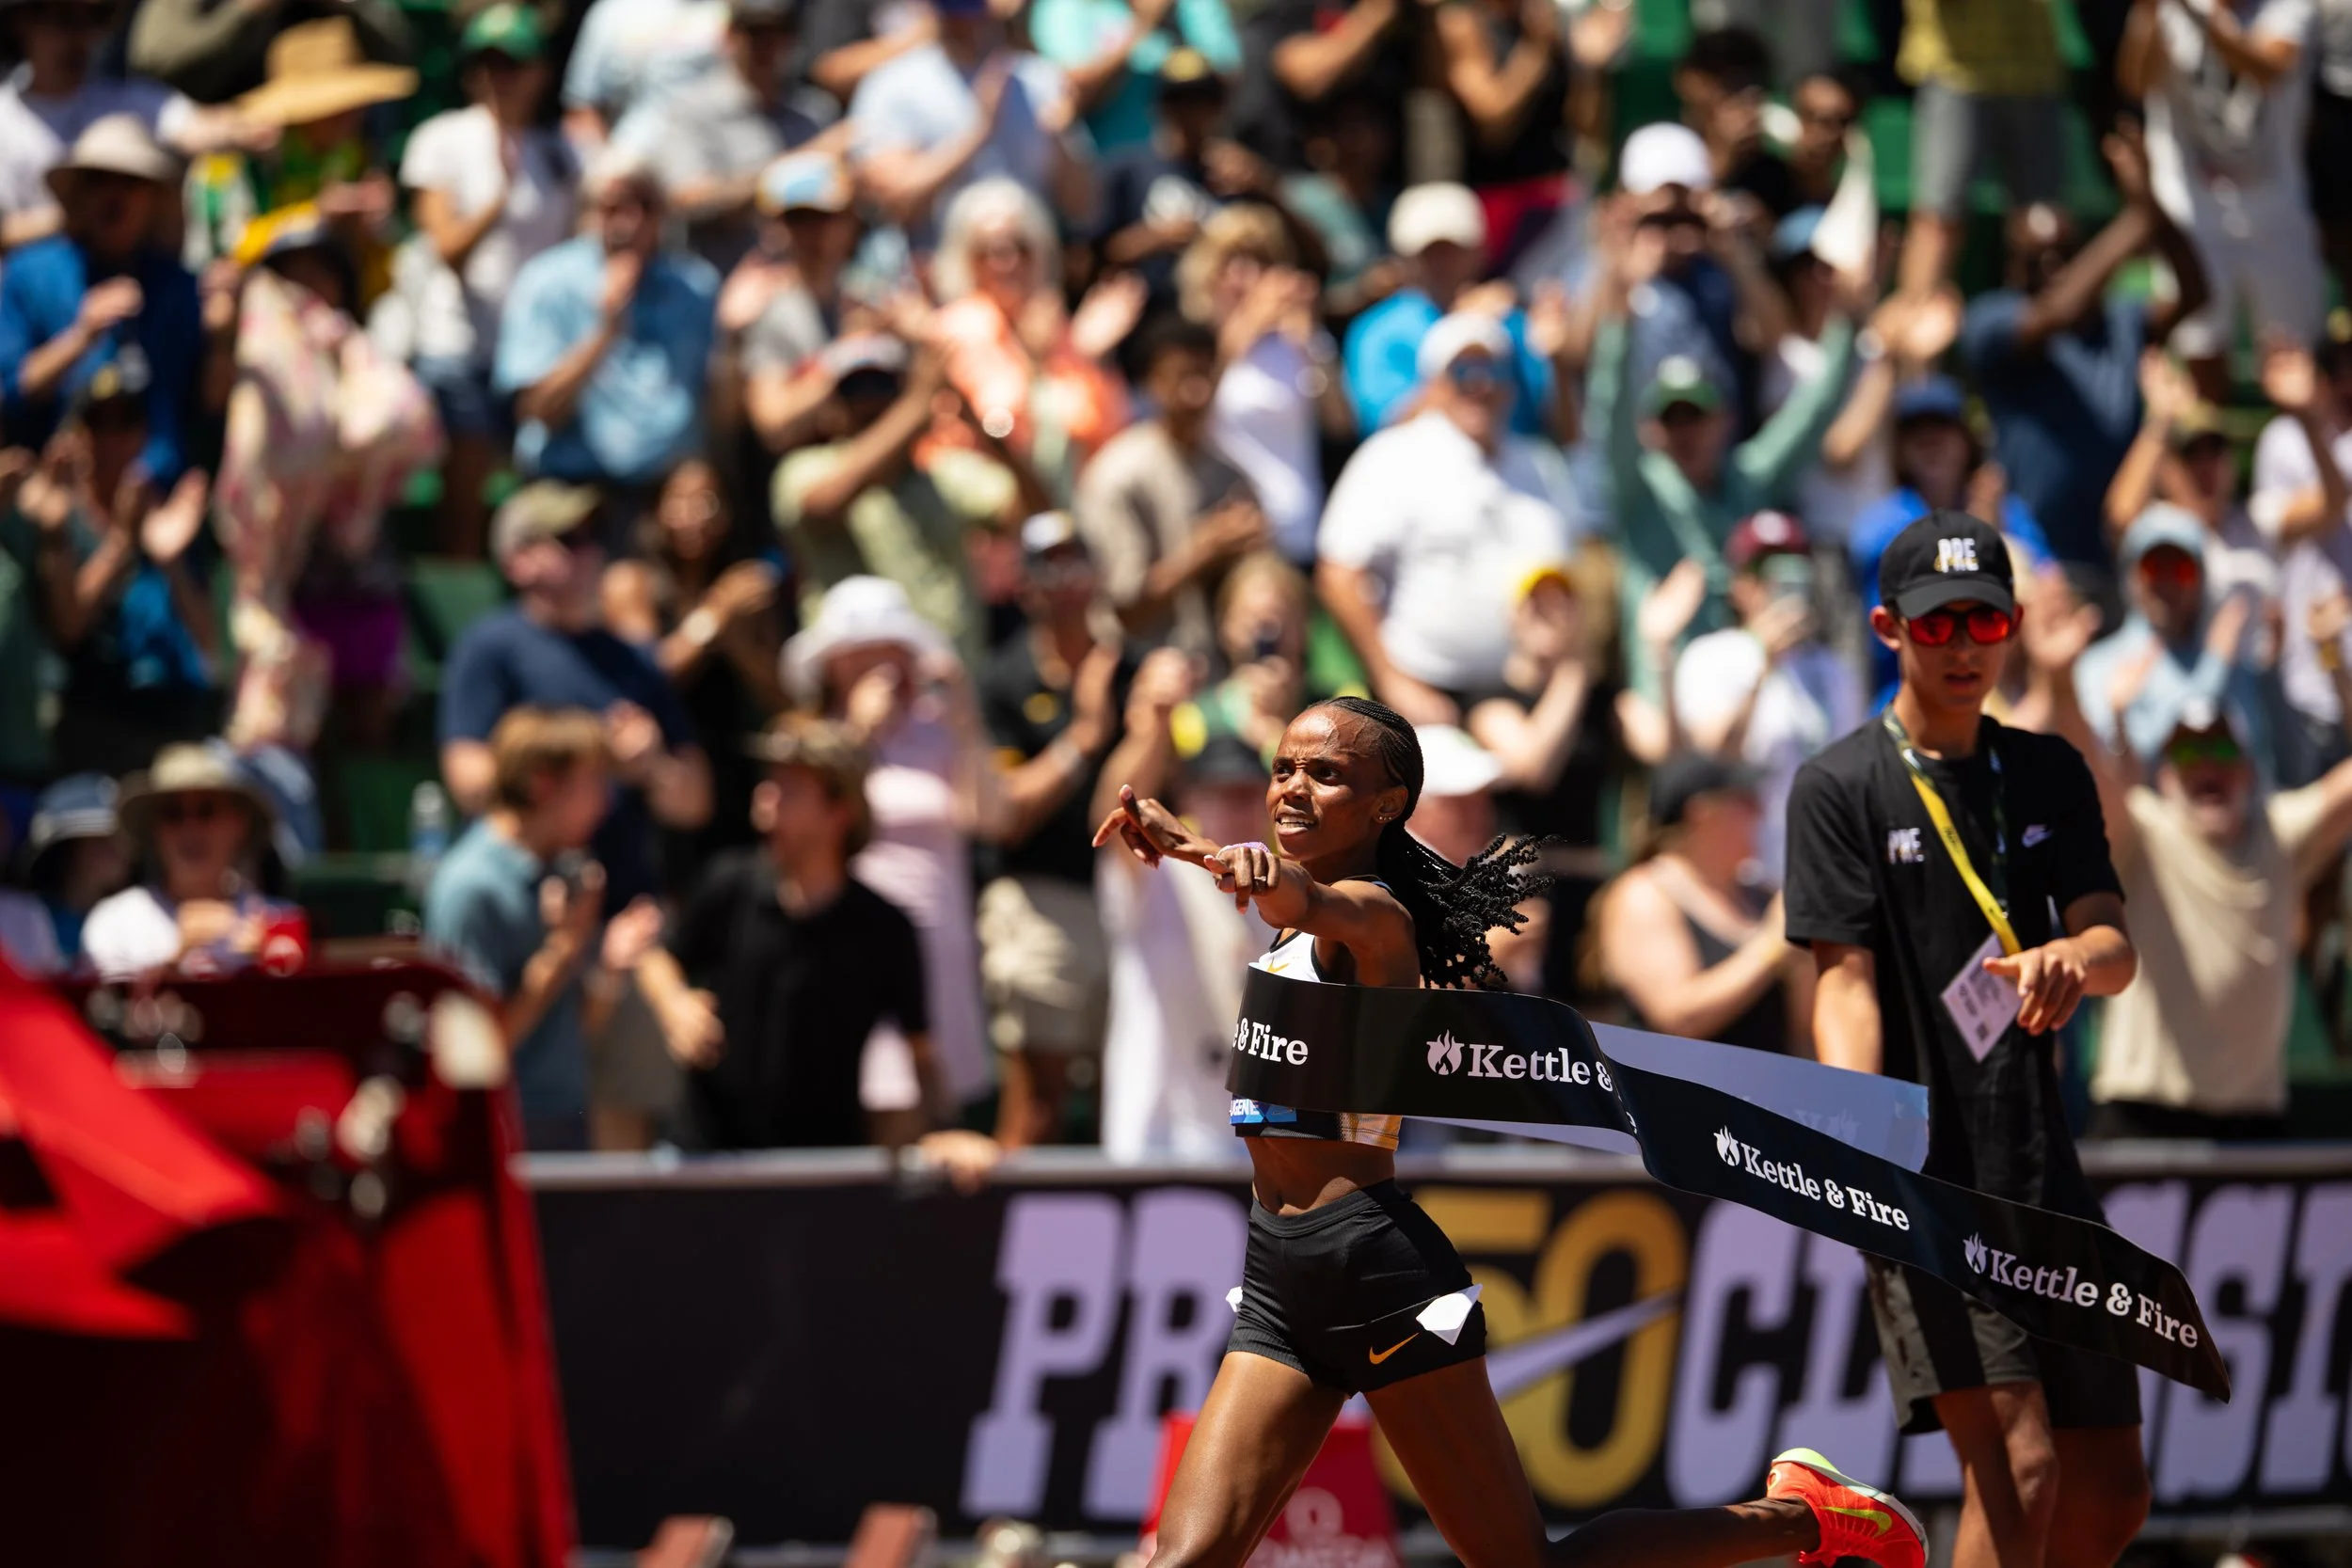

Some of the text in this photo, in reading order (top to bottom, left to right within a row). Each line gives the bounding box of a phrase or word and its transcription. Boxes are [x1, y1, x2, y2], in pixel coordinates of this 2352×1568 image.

[1937, 537, 1979, 573] PRE
[1887, 827, 1925, 864] PRE
[1237, 1017, 1249, 1052] &
[1248, 1021, 1309, 1066] Fire
[1467, 1043, 1613, 1092] Kettle &
[1740, 1142, 1910, 1231] Kettle & Fire
[1989, 1248, 2199, 1349] Kettle & Fire
[960, 1189, 1249, 1516] PR
